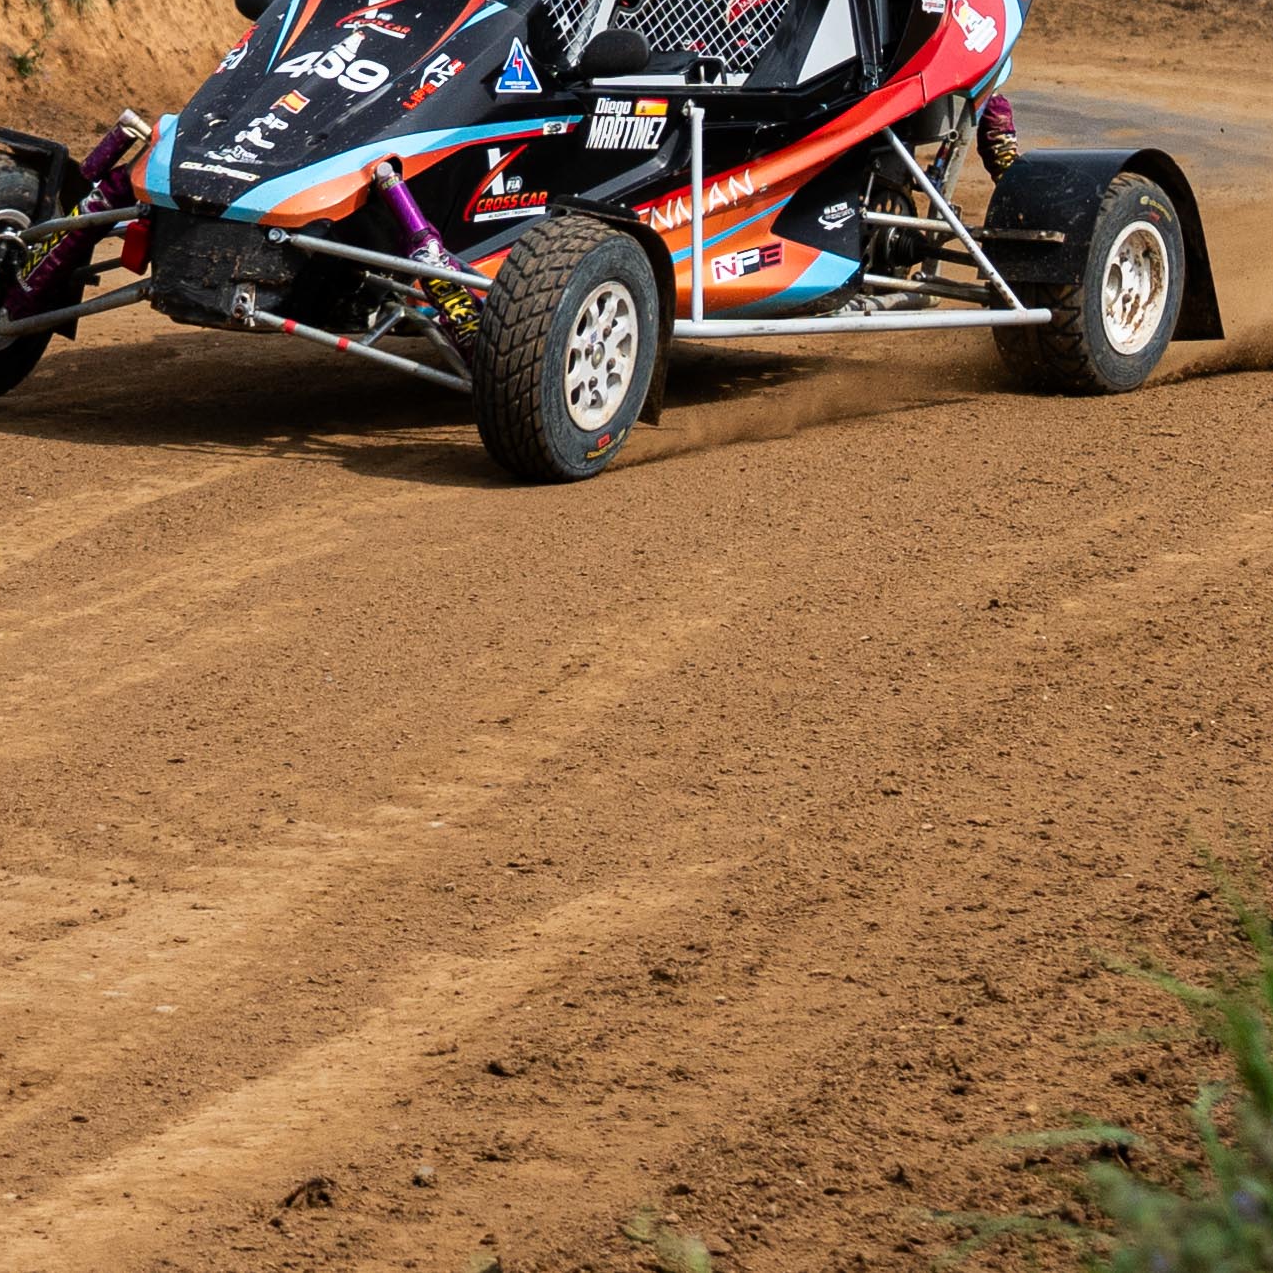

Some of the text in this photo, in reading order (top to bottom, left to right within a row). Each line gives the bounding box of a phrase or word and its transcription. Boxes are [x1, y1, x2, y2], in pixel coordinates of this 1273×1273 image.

[594, 98, 632, 117] Diego
[585, 115, 668, 150] MARTINEZ
[476, 191, 548, 213] CROSS CAR
